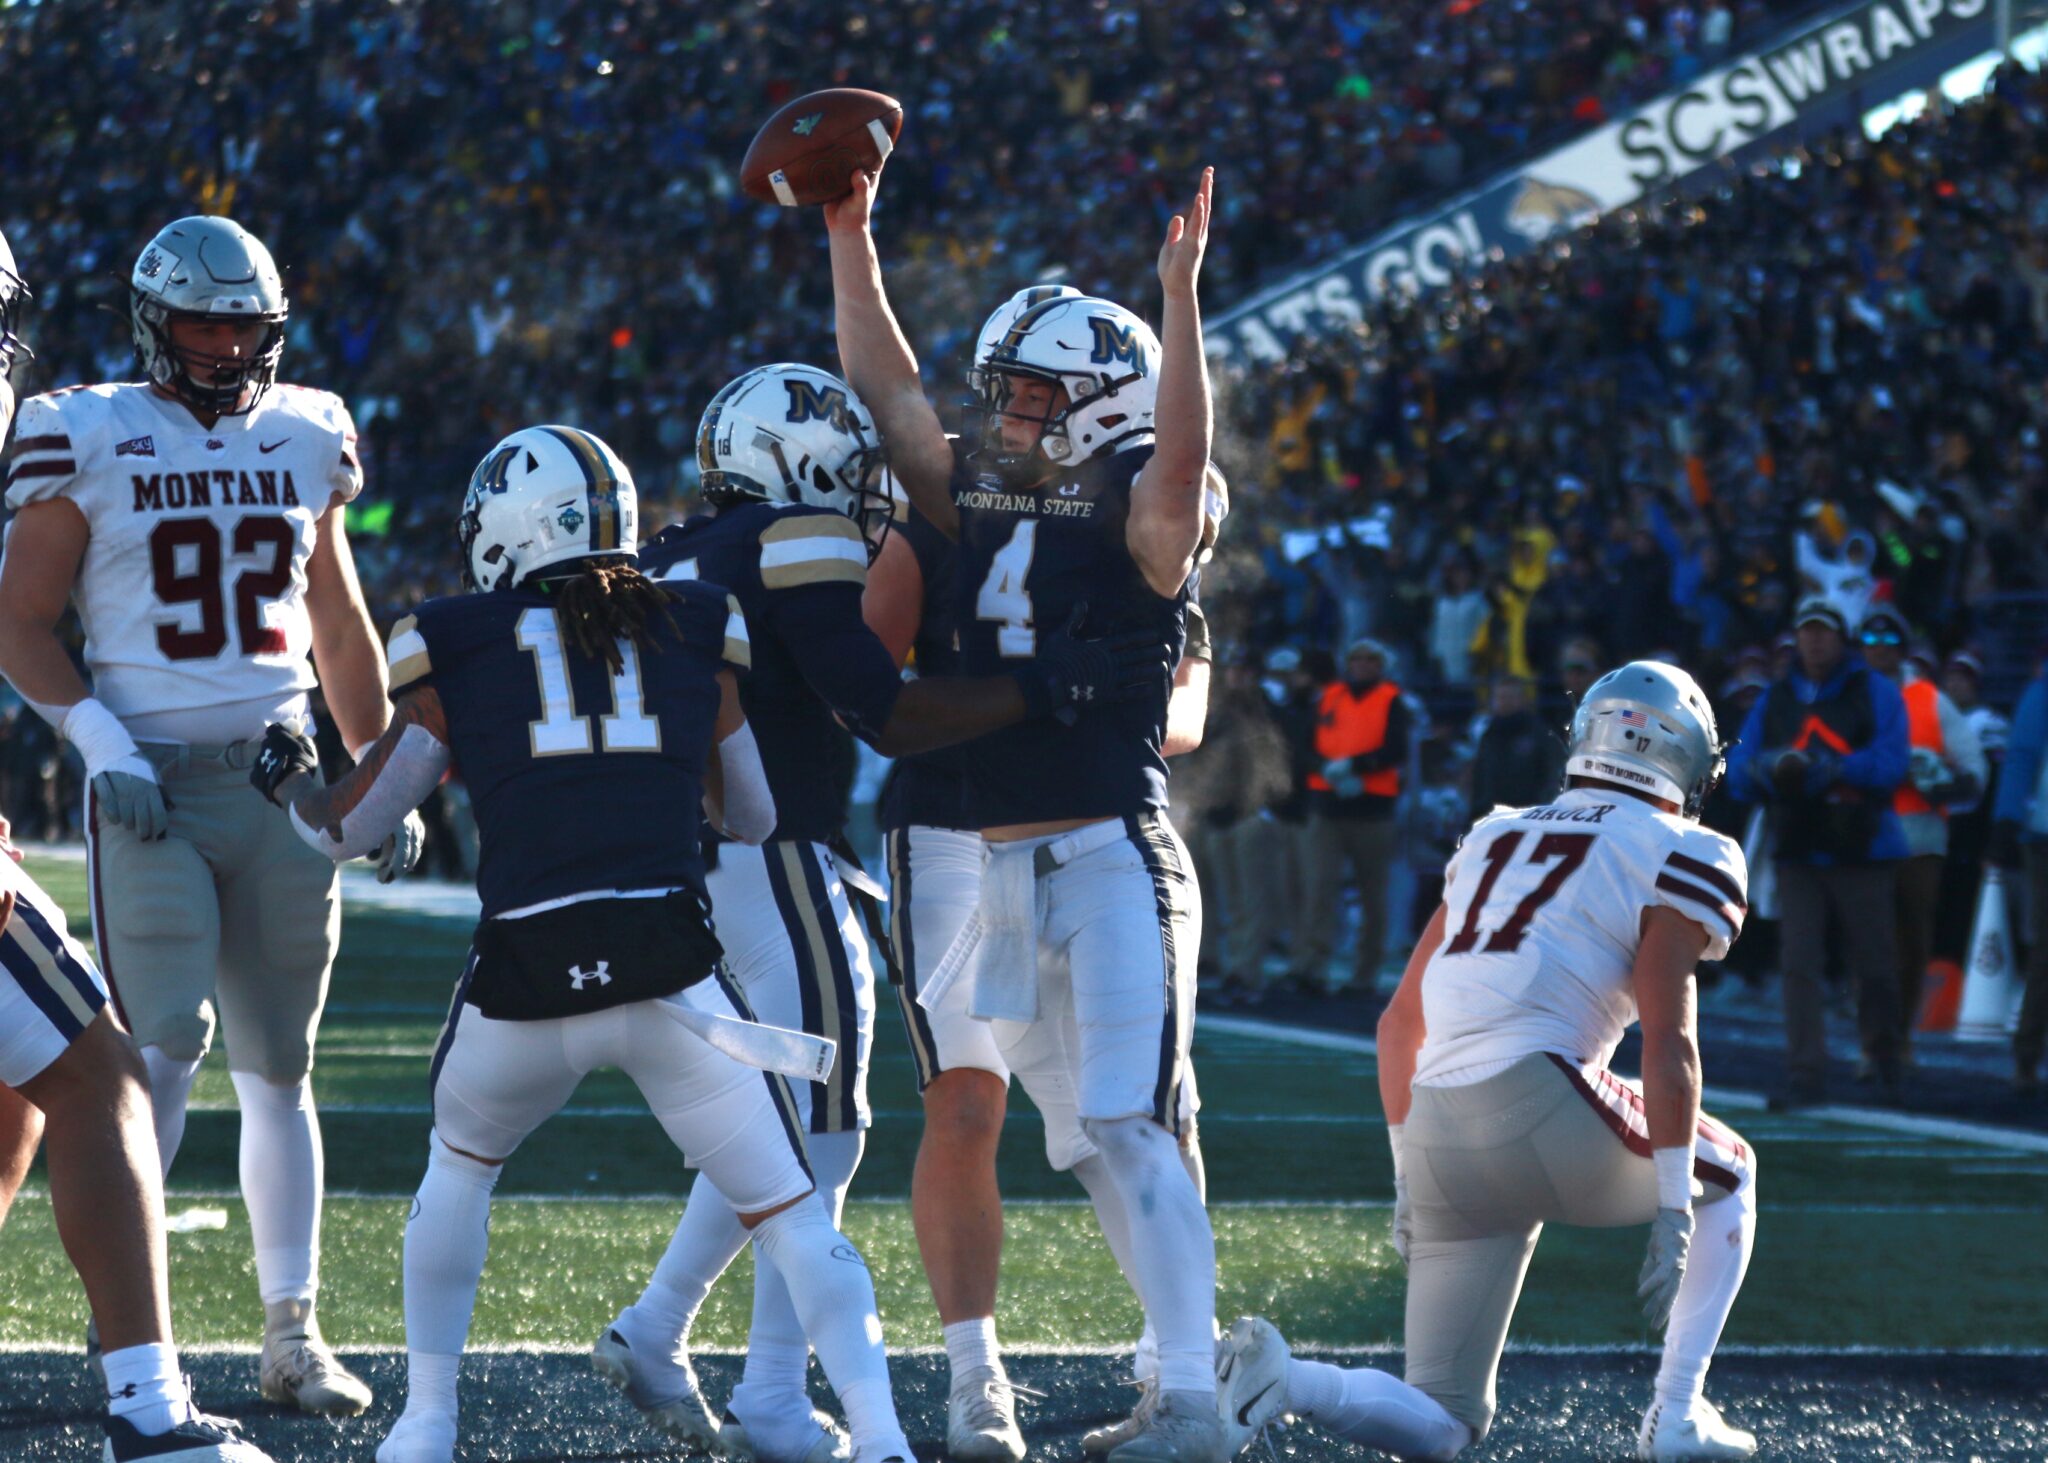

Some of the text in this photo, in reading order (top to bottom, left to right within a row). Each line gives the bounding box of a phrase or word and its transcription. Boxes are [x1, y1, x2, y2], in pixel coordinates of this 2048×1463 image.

[1618, 66, 1773, 186] SCS
[132, 471, 299, 513] MONTANA
[955, 491, 1094, 518] MONTANA STATE
[149, 514, 295, 661] 92
[976, 518, 1040, 658] 4
[515, 607, 662, 759] 11
[1615, 767, 1656, 787] MONTANA
[1636, 736, 1651, 753] 17
[1444, 830, 1598, 956] 17
